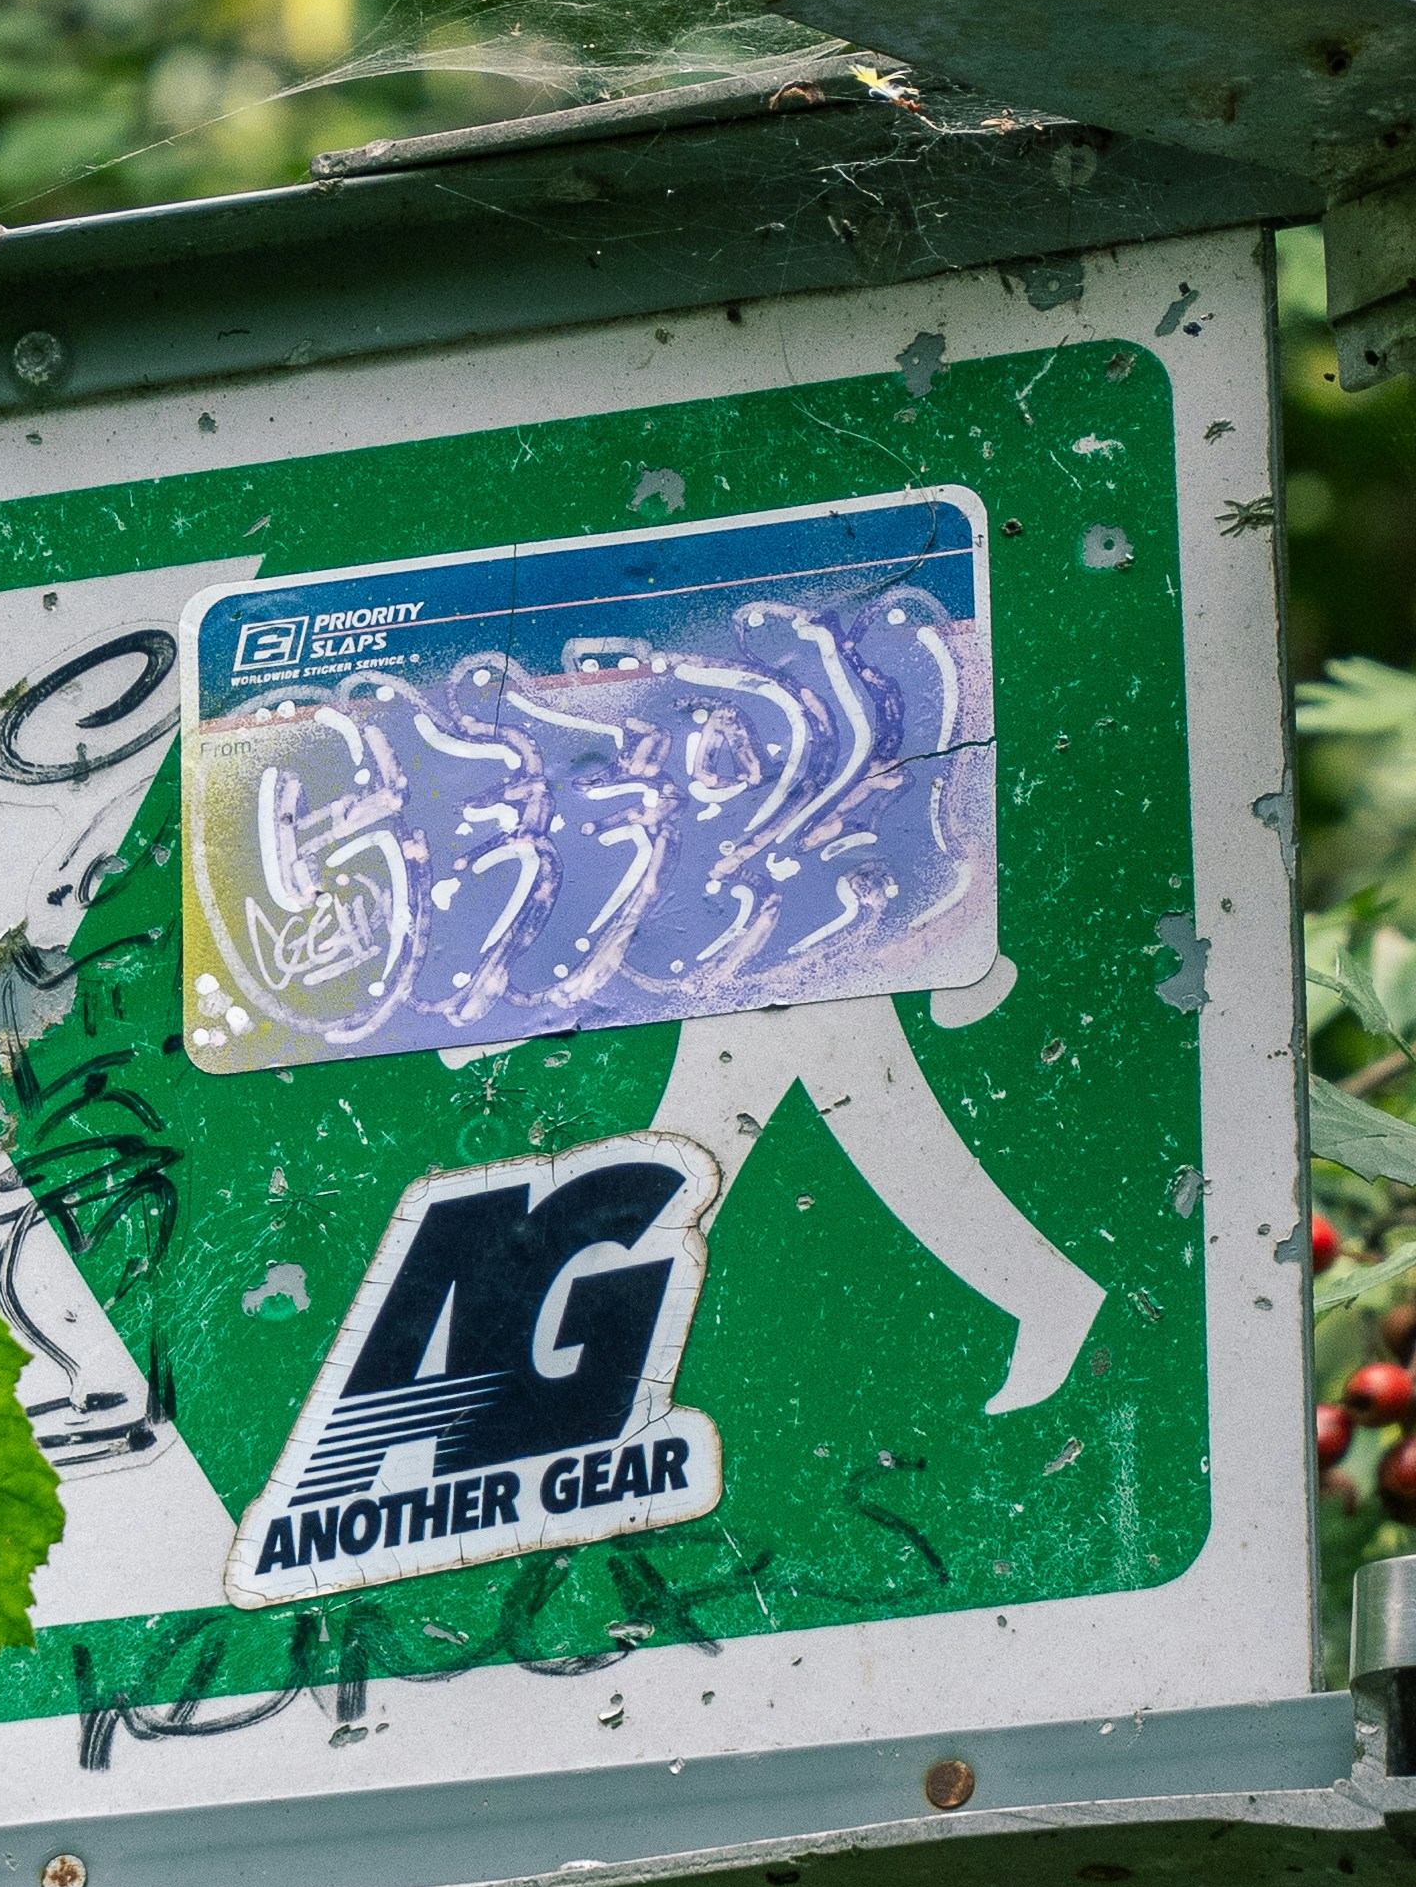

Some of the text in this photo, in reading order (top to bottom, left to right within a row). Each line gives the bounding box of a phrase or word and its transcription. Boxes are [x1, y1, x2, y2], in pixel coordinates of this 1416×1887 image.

[313, 601, 425, 633] PRIORITY
[309, 631, 388, 659] SLAPS
[230, 654, 405, 687] WORLDWIDE STICKER SERVICE
[287, 1160, 687, 1507] AG
[254, 1436, 691, 1576] ANOTHER GEAR
